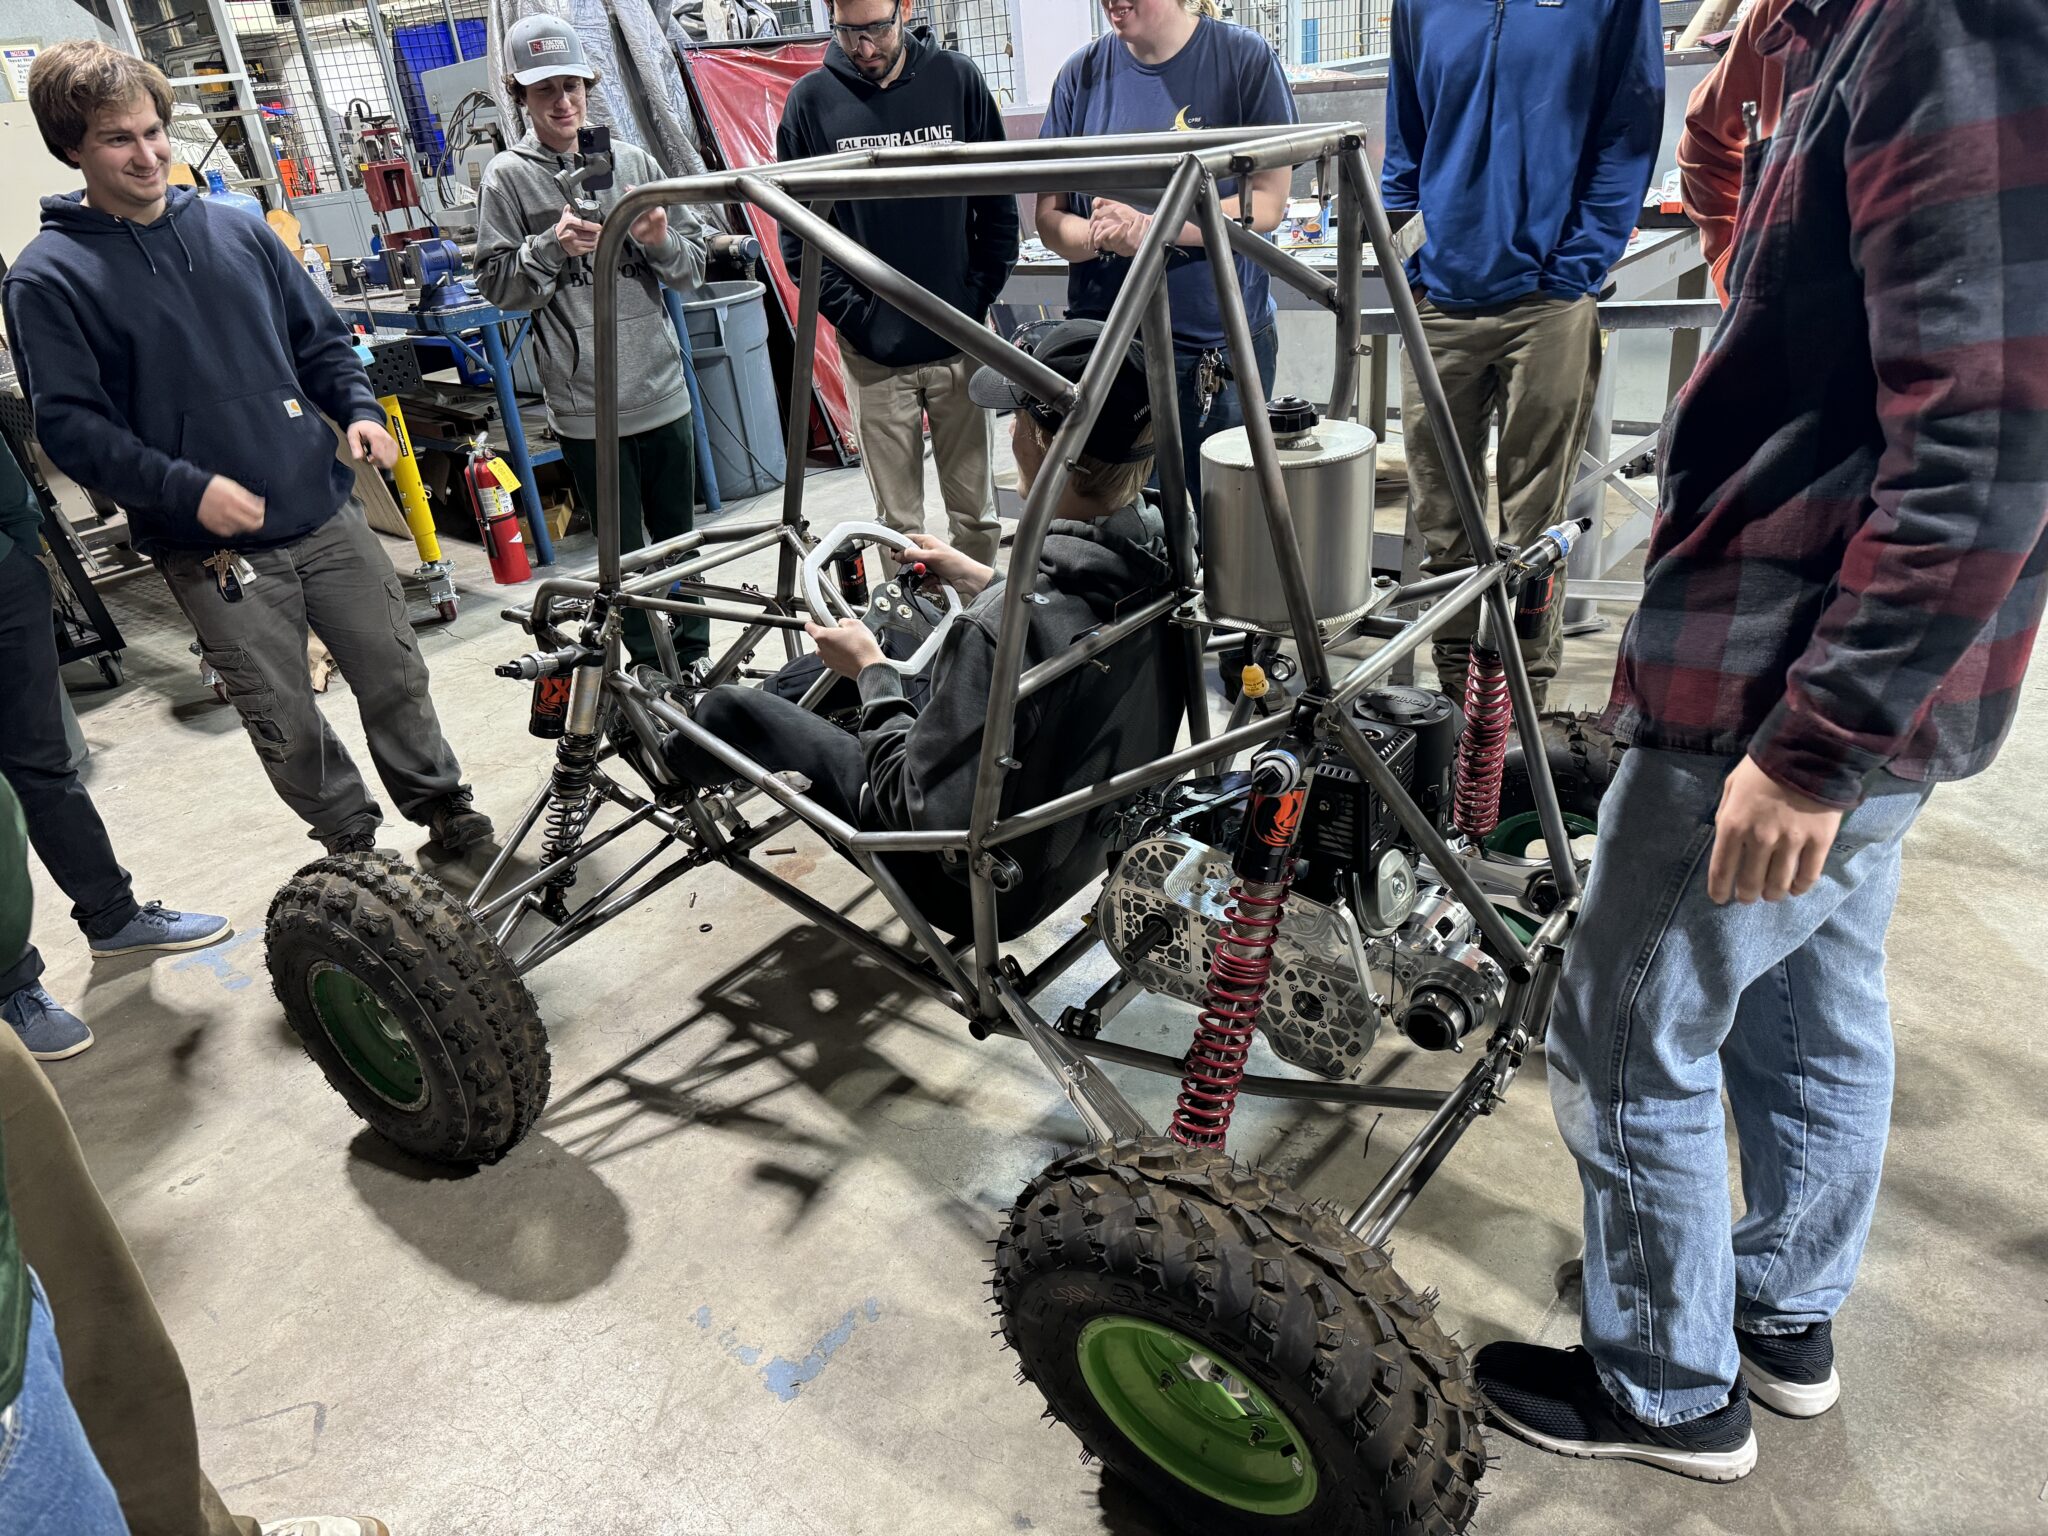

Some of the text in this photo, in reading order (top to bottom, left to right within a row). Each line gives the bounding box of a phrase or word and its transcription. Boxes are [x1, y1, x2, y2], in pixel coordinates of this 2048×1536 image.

[838, 140, 857, 151] CAL
[860, 137, 889, 148] POLY
[889, 125, 952, 147] RACING
[570, 262, 652, 287] BUON
